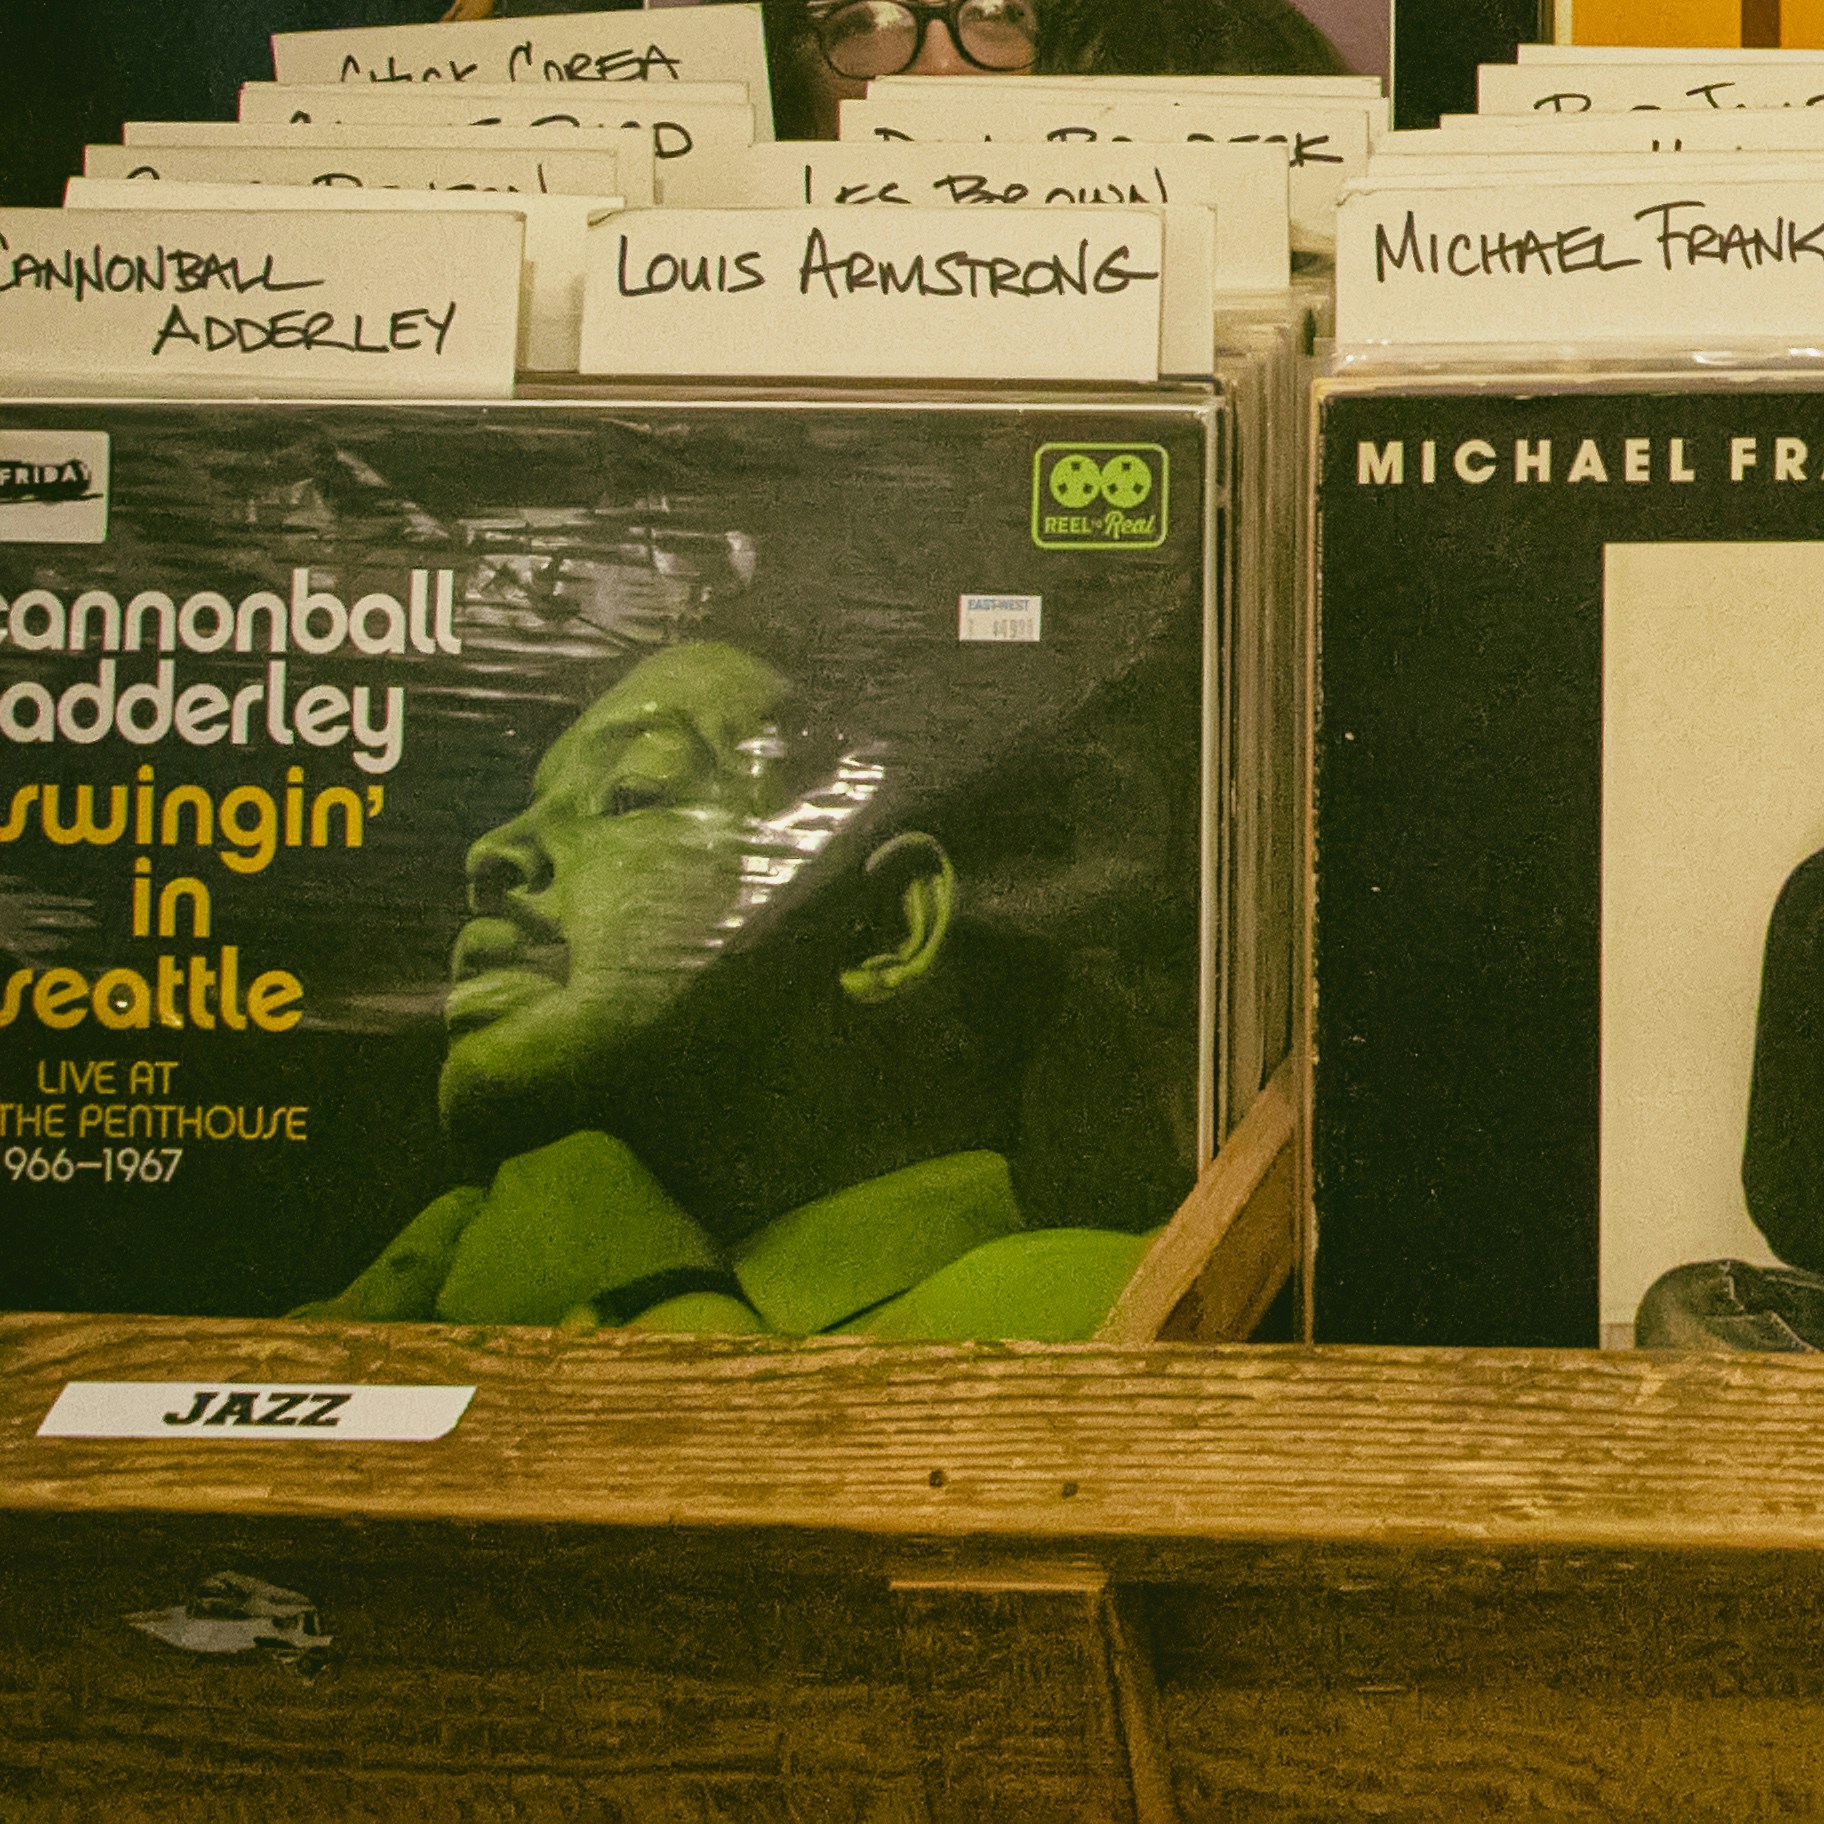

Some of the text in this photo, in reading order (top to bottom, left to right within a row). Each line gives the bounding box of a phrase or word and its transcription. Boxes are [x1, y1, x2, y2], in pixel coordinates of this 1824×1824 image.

[0, 236, 327, 297] CANNONBALL
[617, 228, 1161, 299] LOUIS ARMSTRONG
[1375, 206, 1642, 285] MICHAEL
[152, 302, 459, 355] ADDERLEY
[1357, 434, 1697, 486] MICHAEL
[1044, 516, 1092, 534] REEL
[1104, 510, 1157, 541] Real
[968, 598, 1031, 612] EAST-WEST
[0, 659, 405, 773] adderley
[131, 857, 212, 939] in
[37, 1060, 181, 1095] LIVE AT
[78, 1102, 309, 1142] PENTHOUSE
[161, 1390, 355, 1429] JAZZ
